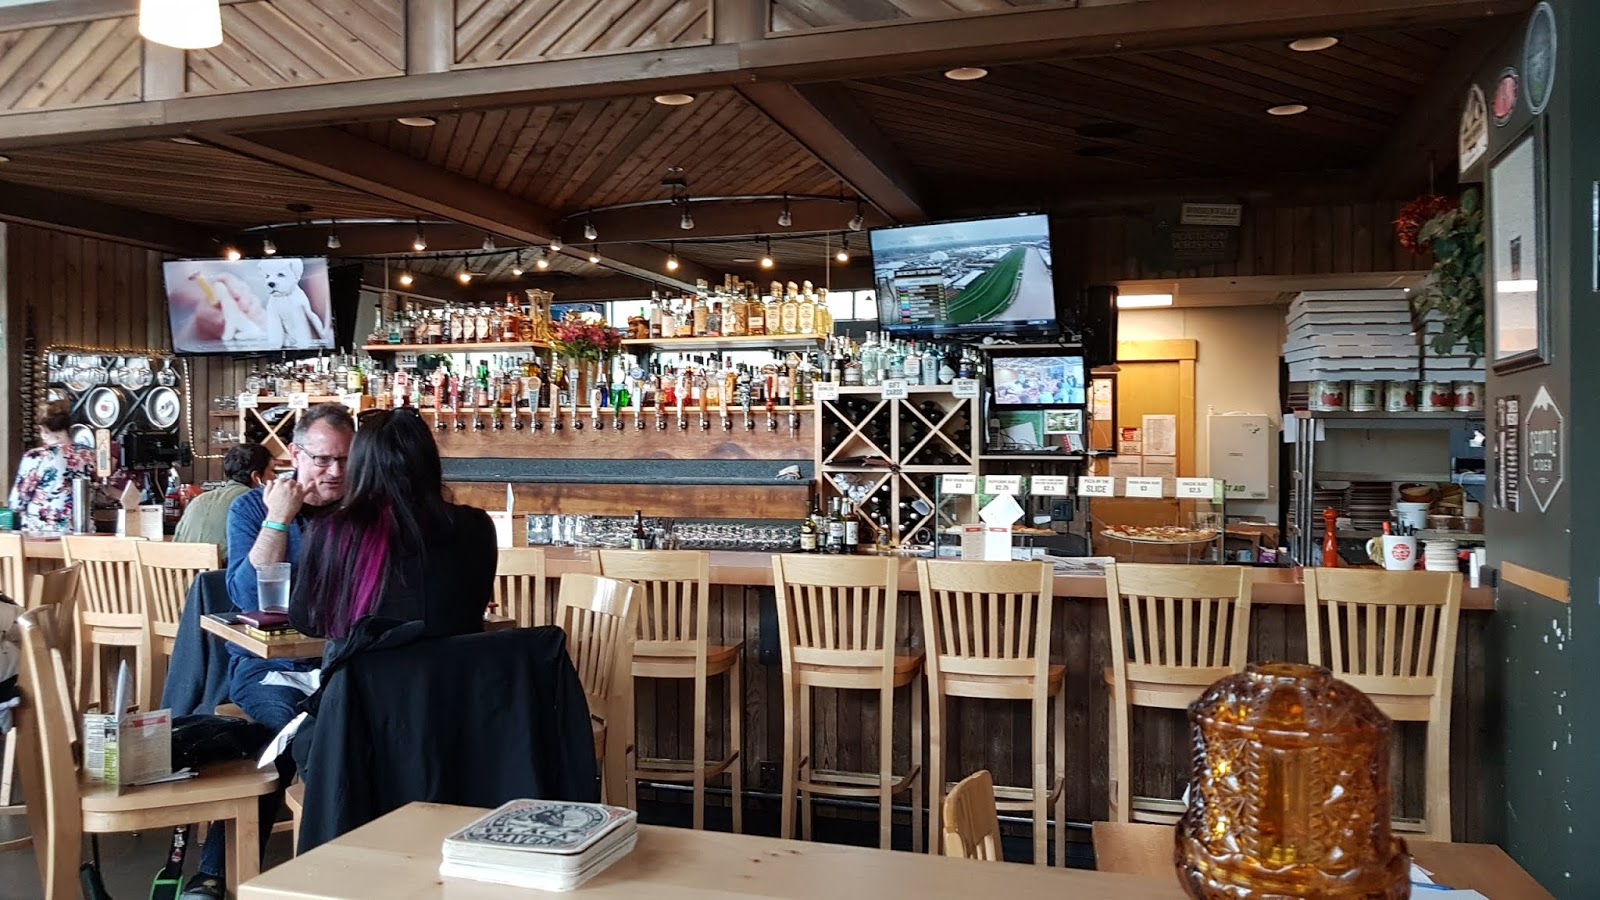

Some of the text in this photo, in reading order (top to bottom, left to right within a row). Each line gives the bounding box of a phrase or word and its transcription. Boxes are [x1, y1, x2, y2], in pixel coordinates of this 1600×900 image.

[1529, 430, 1557, 457] SEATTLE
[1533, 459, 1553, 471] CIDER
[1085, 484, 1108, 494] SLICE
[482, 826, 575, 841] BLACK
[488, 832, 554, 846] RAVEN
